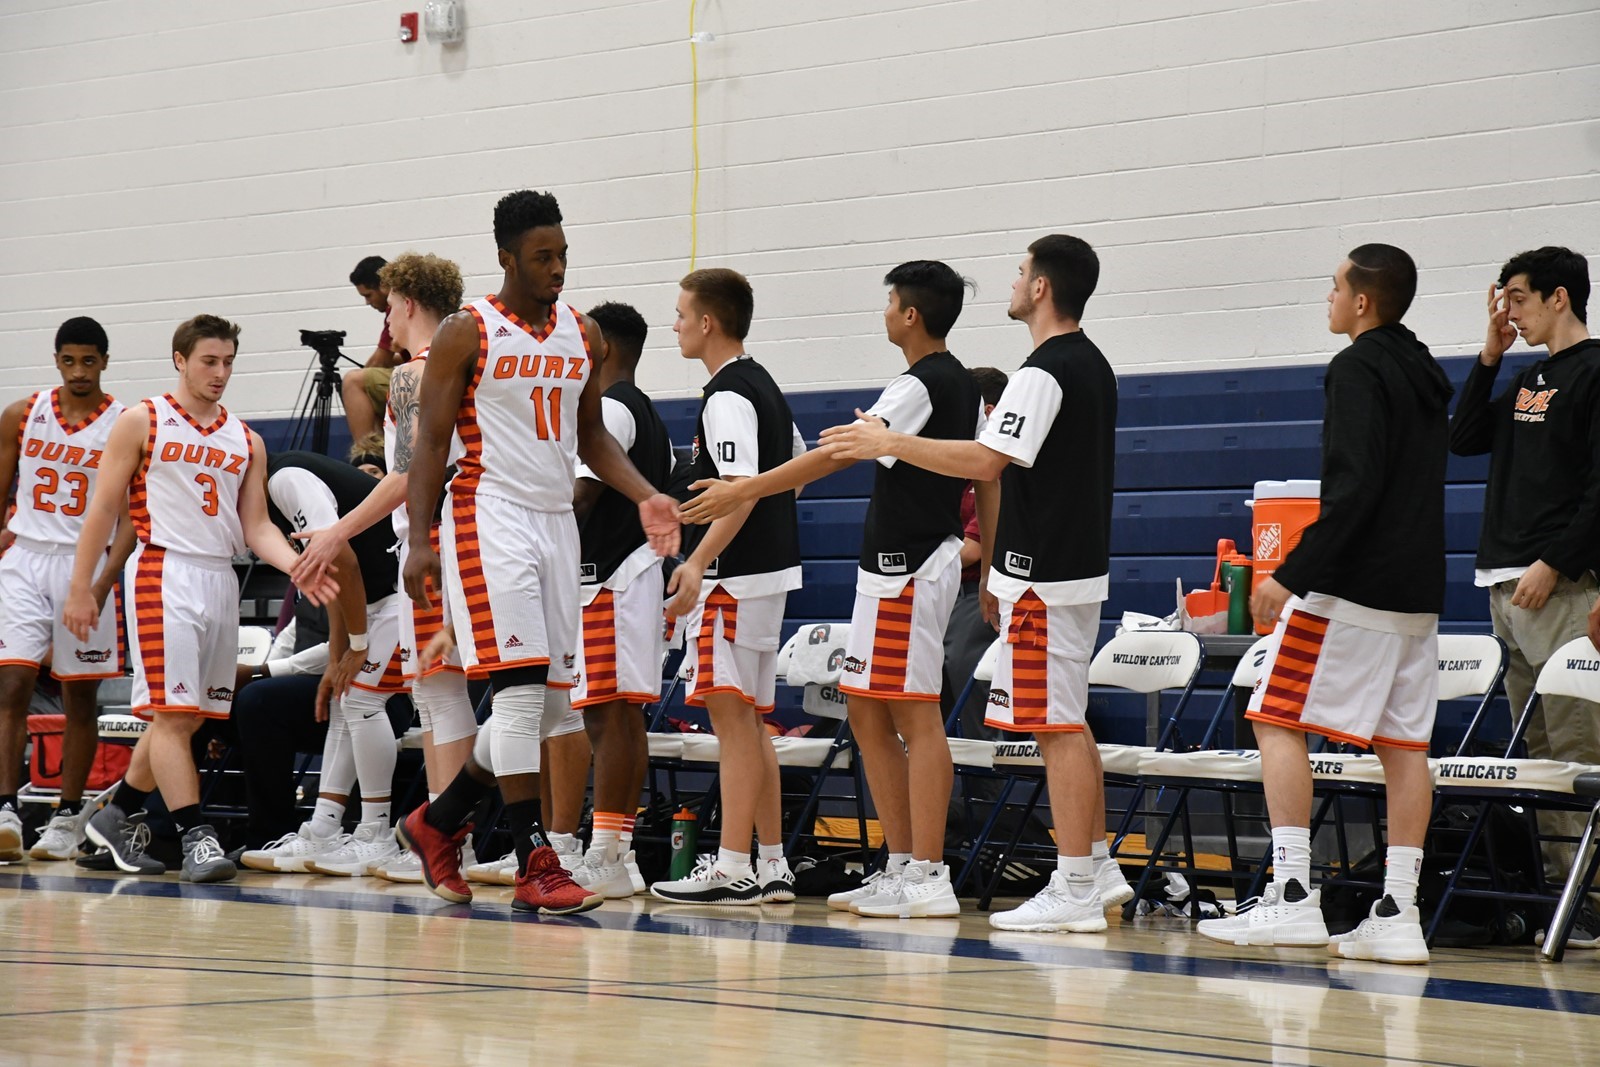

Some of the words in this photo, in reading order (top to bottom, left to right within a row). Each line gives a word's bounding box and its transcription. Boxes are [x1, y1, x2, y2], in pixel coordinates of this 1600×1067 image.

[493, 355, 585, 380] OUAZ
[530, 386, 562, 442] 11
[998, 411, 1027, 440] 21
[160, 442, 247, 476] OUAZ
[33, 467, 89, 517] 23
[194, 473, 219, 517] 3
[1112, 653, 1149, 666] WILLOW
[1149, 655, 1182, 667] CANYON
[1447, 659, 1482, 671] CANYON
[1566, 658, 1600, 671] WILLO
[98, 720, 148, 732] WILDCATS
[994, 744, 1042, 758] WILDCA
[1439, 763, 1518, 780] WILDCATS
